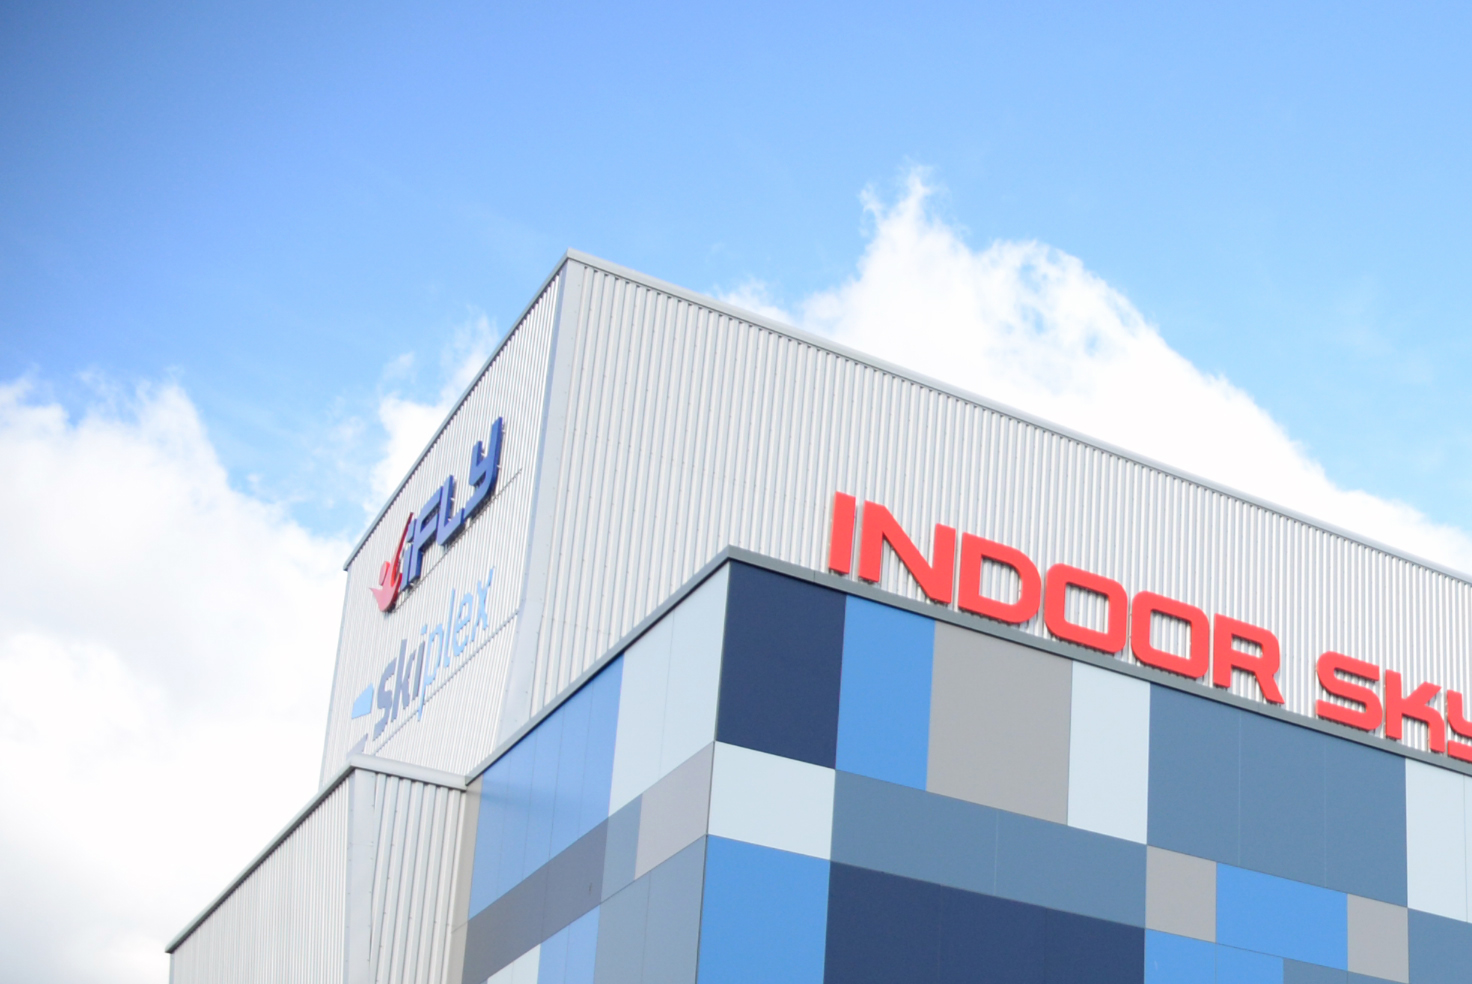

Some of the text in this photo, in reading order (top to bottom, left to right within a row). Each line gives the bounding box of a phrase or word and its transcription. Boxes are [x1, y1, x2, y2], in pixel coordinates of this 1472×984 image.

[400, 416, 503, 592] iFLY
[373, 566, 495, 741] skiplex
[828, 490, 1285, 704] INDOOR
